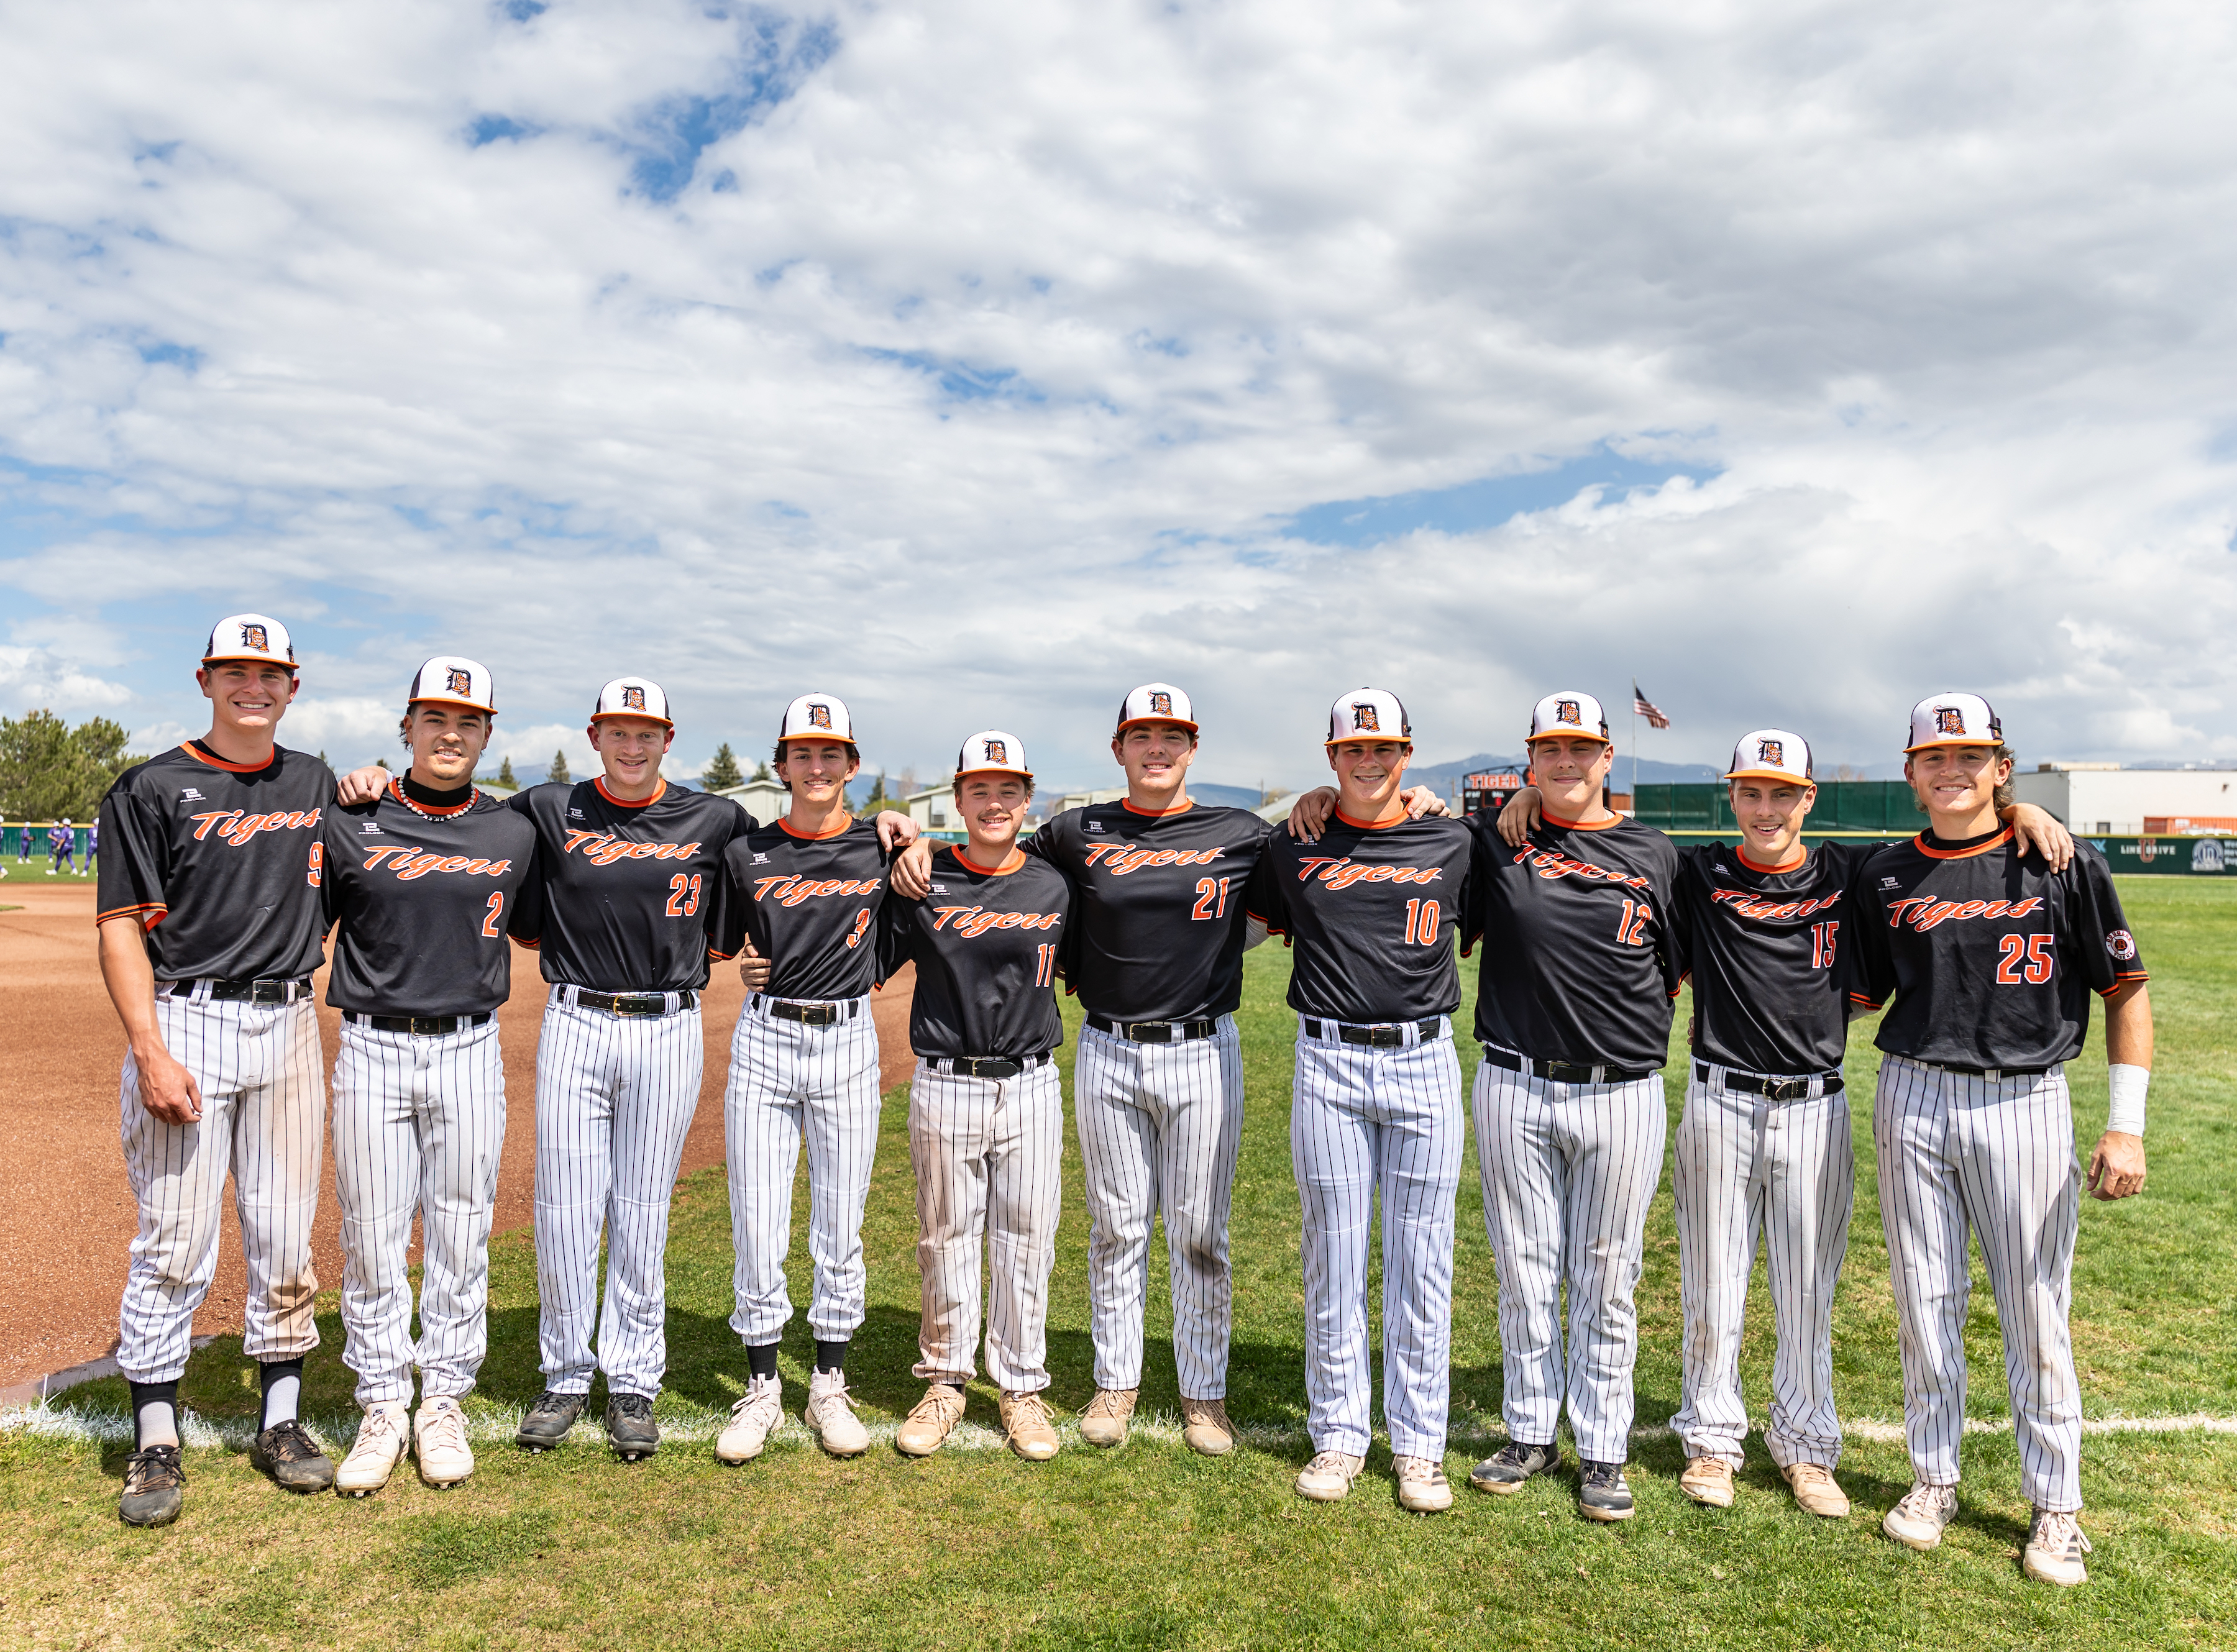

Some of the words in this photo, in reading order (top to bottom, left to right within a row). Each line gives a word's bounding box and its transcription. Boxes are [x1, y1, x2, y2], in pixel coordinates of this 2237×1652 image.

[1468, 774, 1520, 789] TIGER
[190, 807, 323, 847] Tigers
[307, 841, 324, 888] 9
[363, 846, 512, 881] Tigers
[564, 829, 702, 866] Tigers
[1084, 842, 1226, 876] Tigers
[2120, 845, 2141, 855] LINE
[2146, 845, 2176, 856] DRIVE
[753, 874, 882, 907] Tigers
[1298, 857, 1443, 891] Tigers
[482, 891, 504, 938] 2
[665, 873, 702, 917] 23
[1191, 877, 1230, 921] 21
[1711, 887, 1843, 920] Tigers
[1887, 895, 2044, 933] Tigers
[846, 908, 871, 949] 3
[933, 905, 1061, 939] Tigers
[1405, 898, 1440, 946] 10
[1616, 899, 1652, 947] 12
[1035, 942, 1056, 987] 11
[1811, 920, 1839, 969] 15
[1996, 933, 2054, 984] 25
